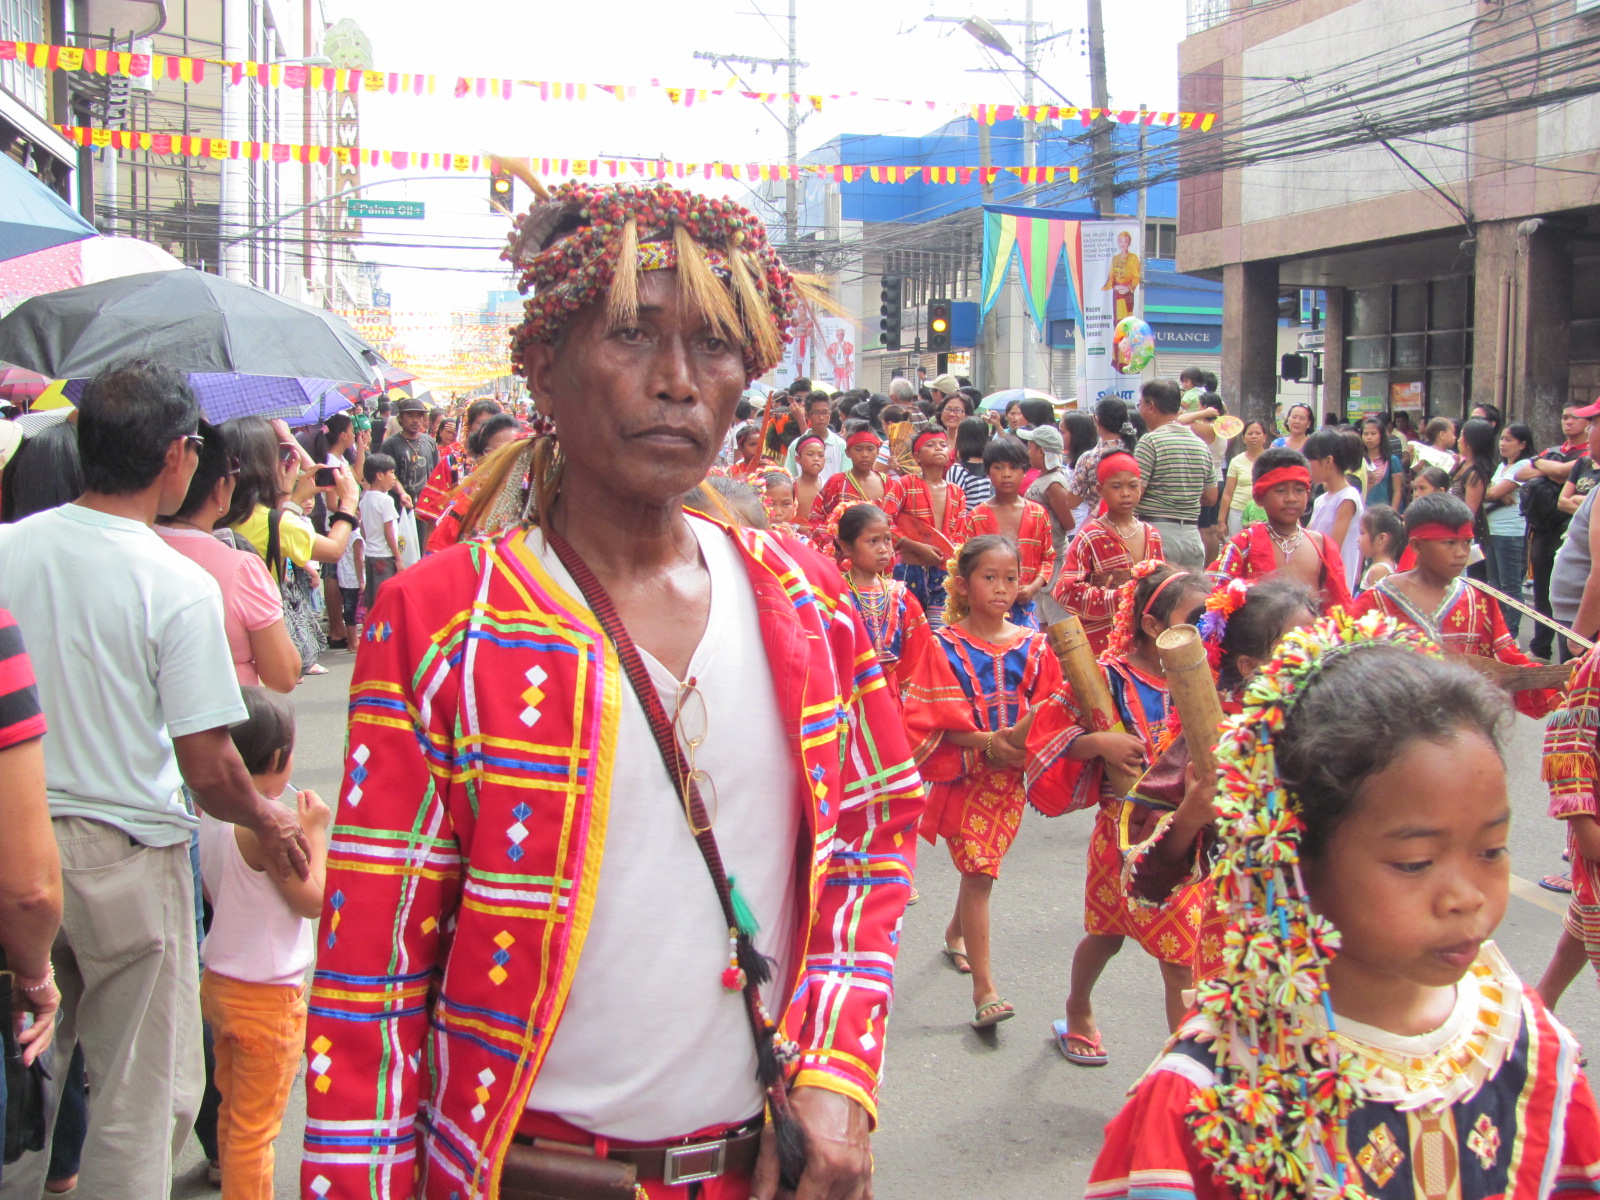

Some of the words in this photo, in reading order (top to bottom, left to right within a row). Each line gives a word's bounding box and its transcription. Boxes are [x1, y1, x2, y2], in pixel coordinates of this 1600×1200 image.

[360, 204, 395, 215] Palma
[398, 205, 413, 216] Gil
[1152, 332, 1210, 342] SURANCE
[1304, 336, 1314, 344] ONE
[1096, 390, 1135, 401] SART
